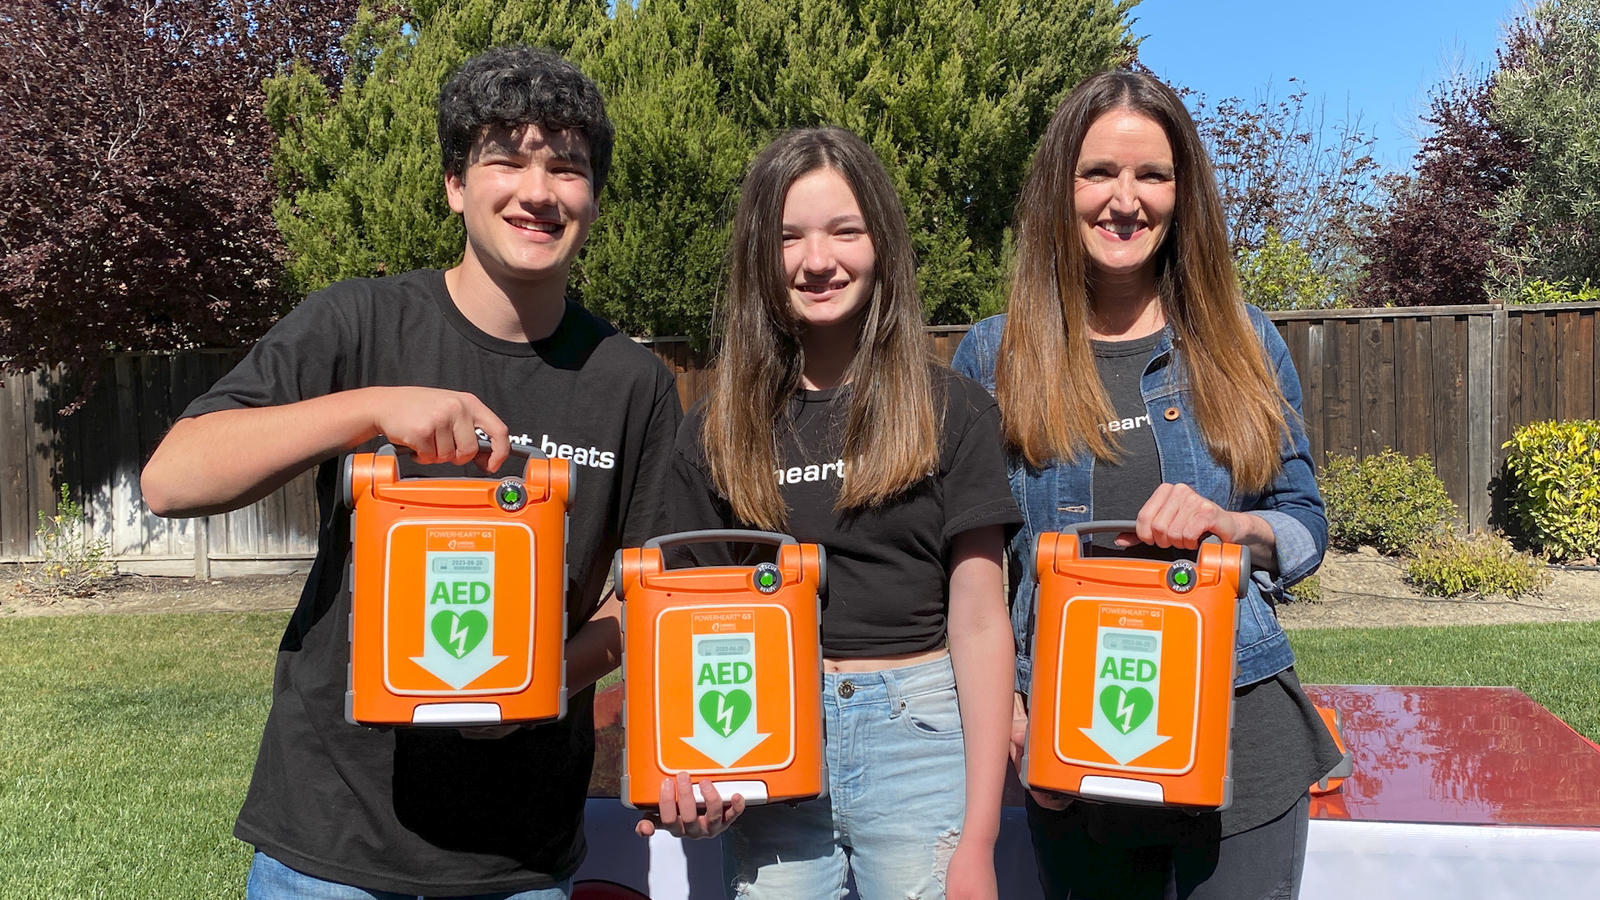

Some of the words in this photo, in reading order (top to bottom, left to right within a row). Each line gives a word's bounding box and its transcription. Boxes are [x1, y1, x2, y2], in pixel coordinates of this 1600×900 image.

[540, 434, 615, 469] beats
[501, 480, 522, 489] RESCUE
[758, 564, 777, 572] RESCUE
[1172, 562, 1192, 571] RESCUE
[430, 581, 491, 605] AED
[697, 661, 753, 686] AED
[1099, 656, 1157, 683] AED
